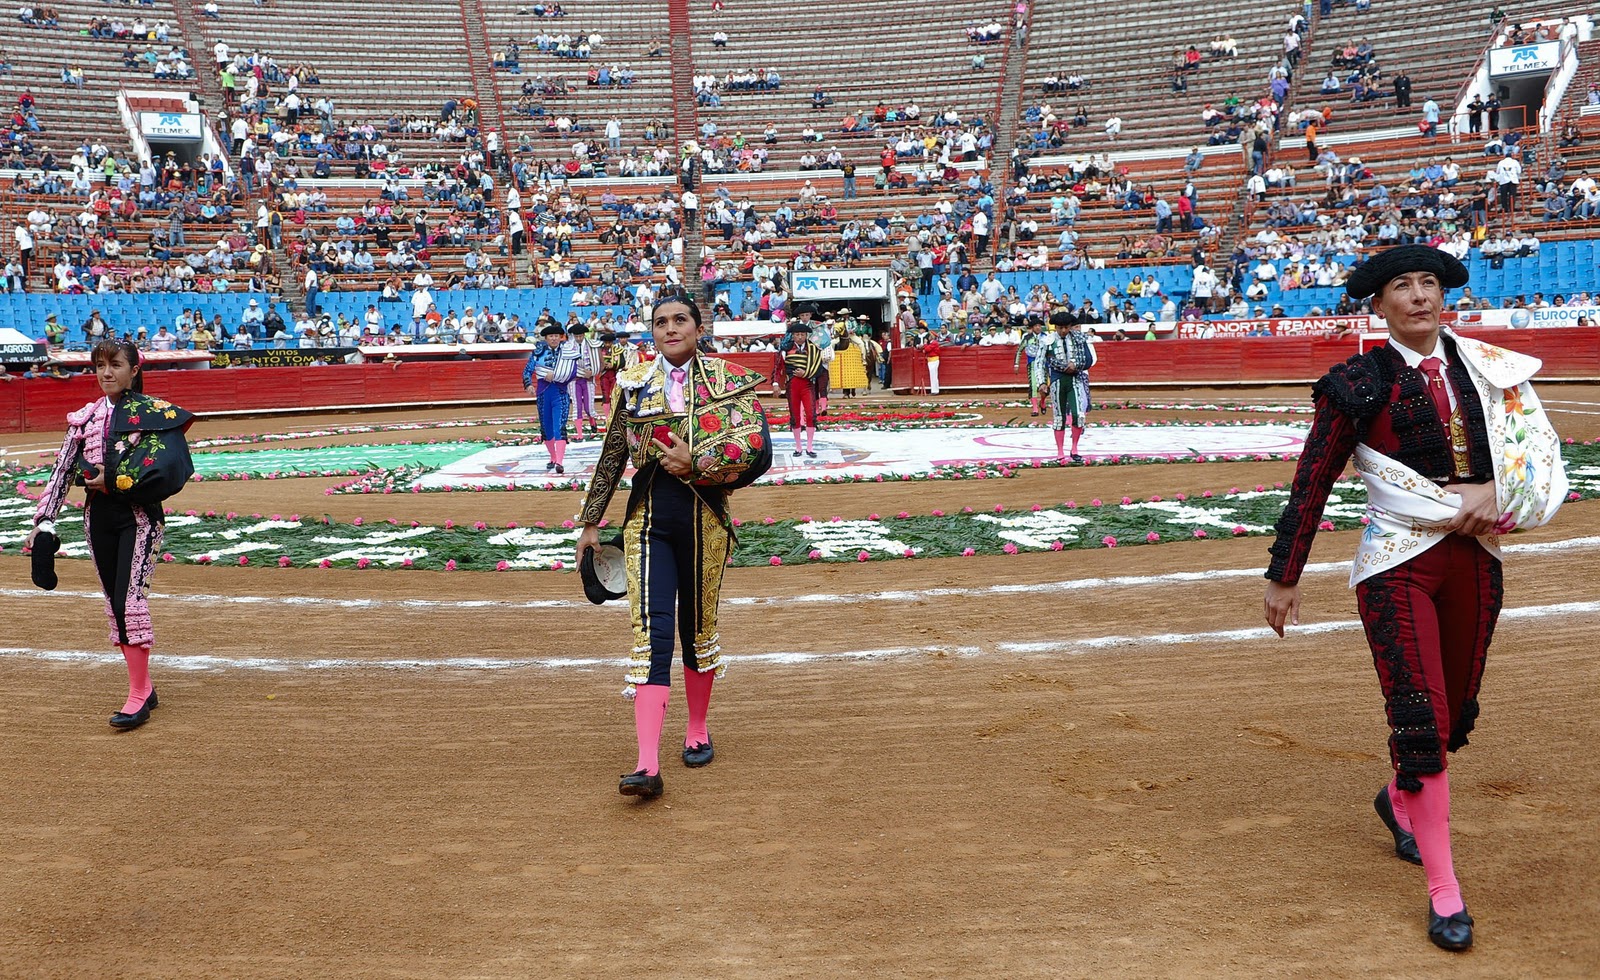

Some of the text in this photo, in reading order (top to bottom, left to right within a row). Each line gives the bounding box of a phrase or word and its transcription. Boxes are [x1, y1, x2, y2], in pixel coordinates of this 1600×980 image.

[1502, 60, 1548, 72] TELMEX
[819, 277, 882, 289] TELMEX
[1533, 320, 1568, 328] MEXICO
[235, 355, 332, 364] SNTO TOMS
